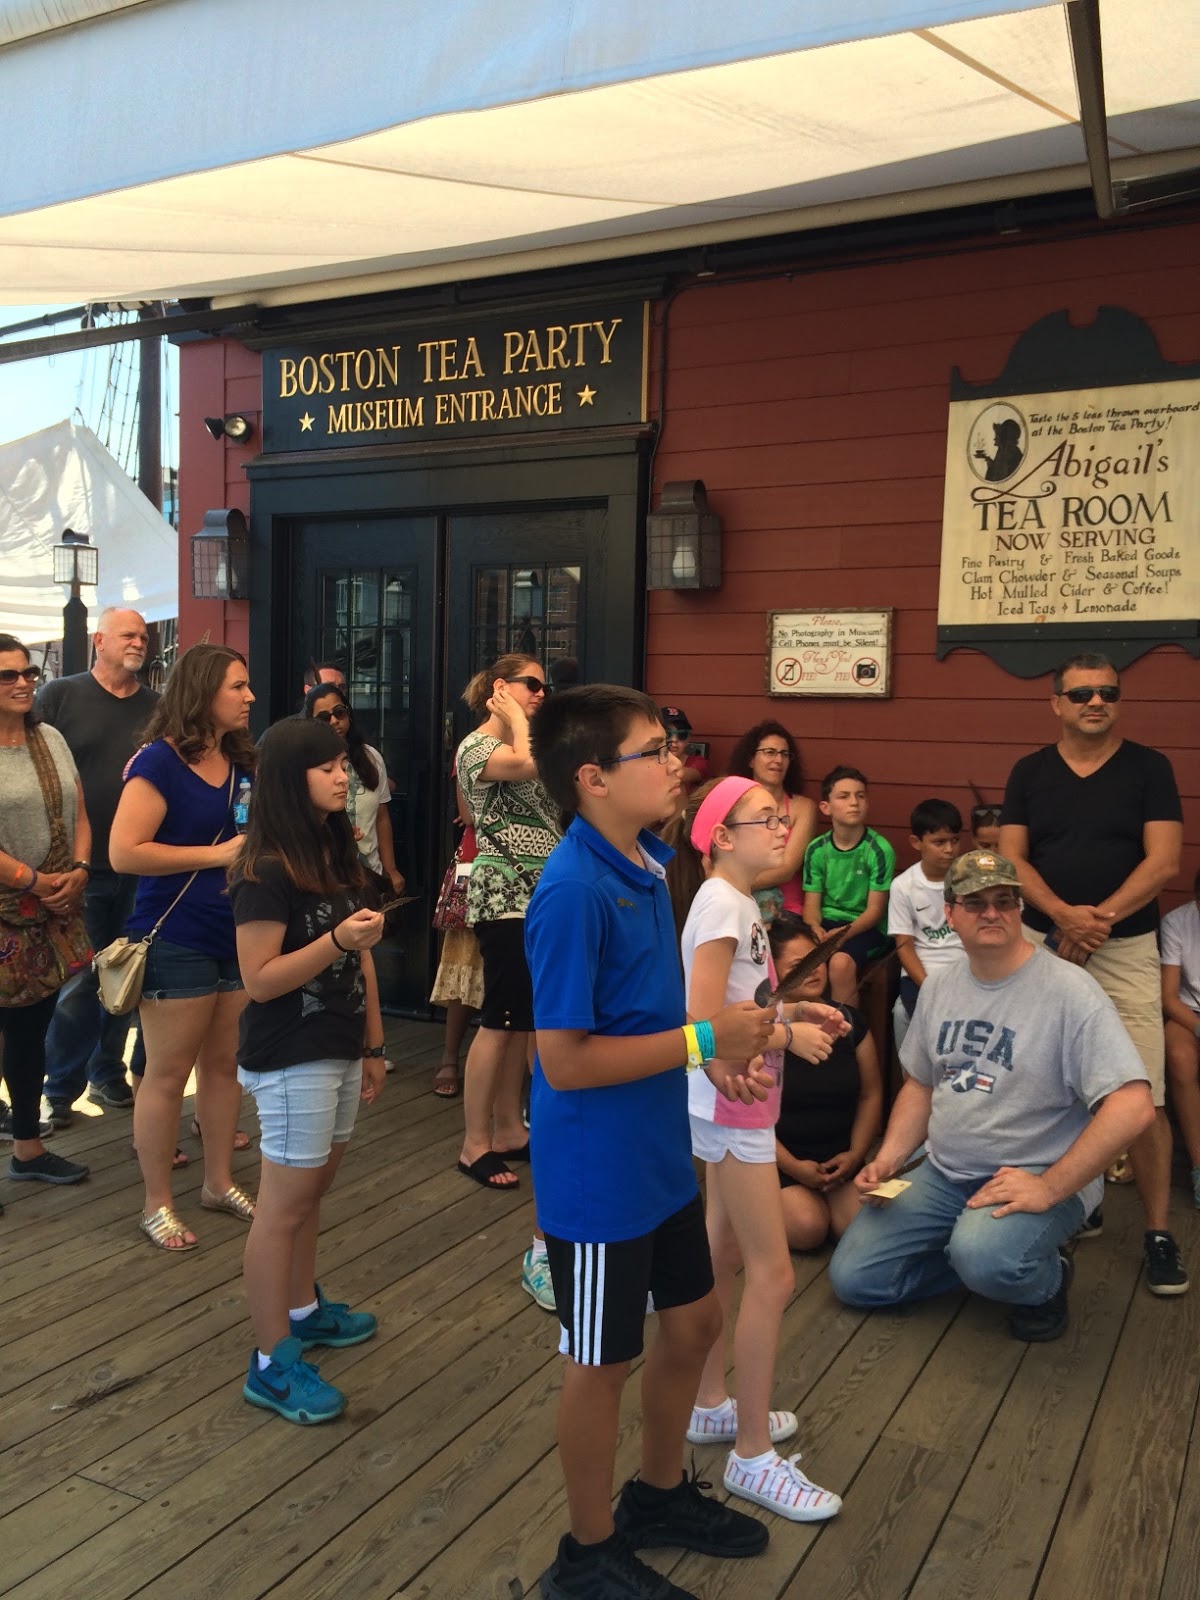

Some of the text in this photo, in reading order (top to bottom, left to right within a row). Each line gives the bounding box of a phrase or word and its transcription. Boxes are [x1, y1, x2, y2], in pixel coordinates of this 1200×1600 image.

[279, 319, 623, 398] BOSTON TEA PARTY
[327, 382, 562, 434] MUSEUM ENTRANCE
[1028, 413, 1052, 424] Taste
[1056, 412, 1069, 422] the
[1106, 408, 1139, 418] thrown
[1143, 402, 1200, 415] overboard
[1031, 415, 1172, 437] at the Boston Tea Party!
[1003, 438, 1169, 495] Abigail's
[973, 491, 1173, 531] TEA ROOM
[995, 528, 1156, 551] NOW SERVING
[962, 556, 982, 568] Fine
[988, 554, 1025, 571] Pastry
[1040, 553, 1053, 566] &
[1064, 551, 1094, 564] Fresh
[1144, 547, 1180, 560] Goods
[962, 563, 1182, 584] Clam Chowder & Seasonal Soups
[970, 581, 1168, 600] Hot Mulled Cider & Coffee!
[997, 601, 1024, 616] Iced
[1029, 600, 1056, 614] Teas
[1075, 599, 1136, 613] Lemonade
[778, 630, 788, 638] No
[791, 629, 834, 638] Photography
[936, 1019, 1017, 1072] USA
